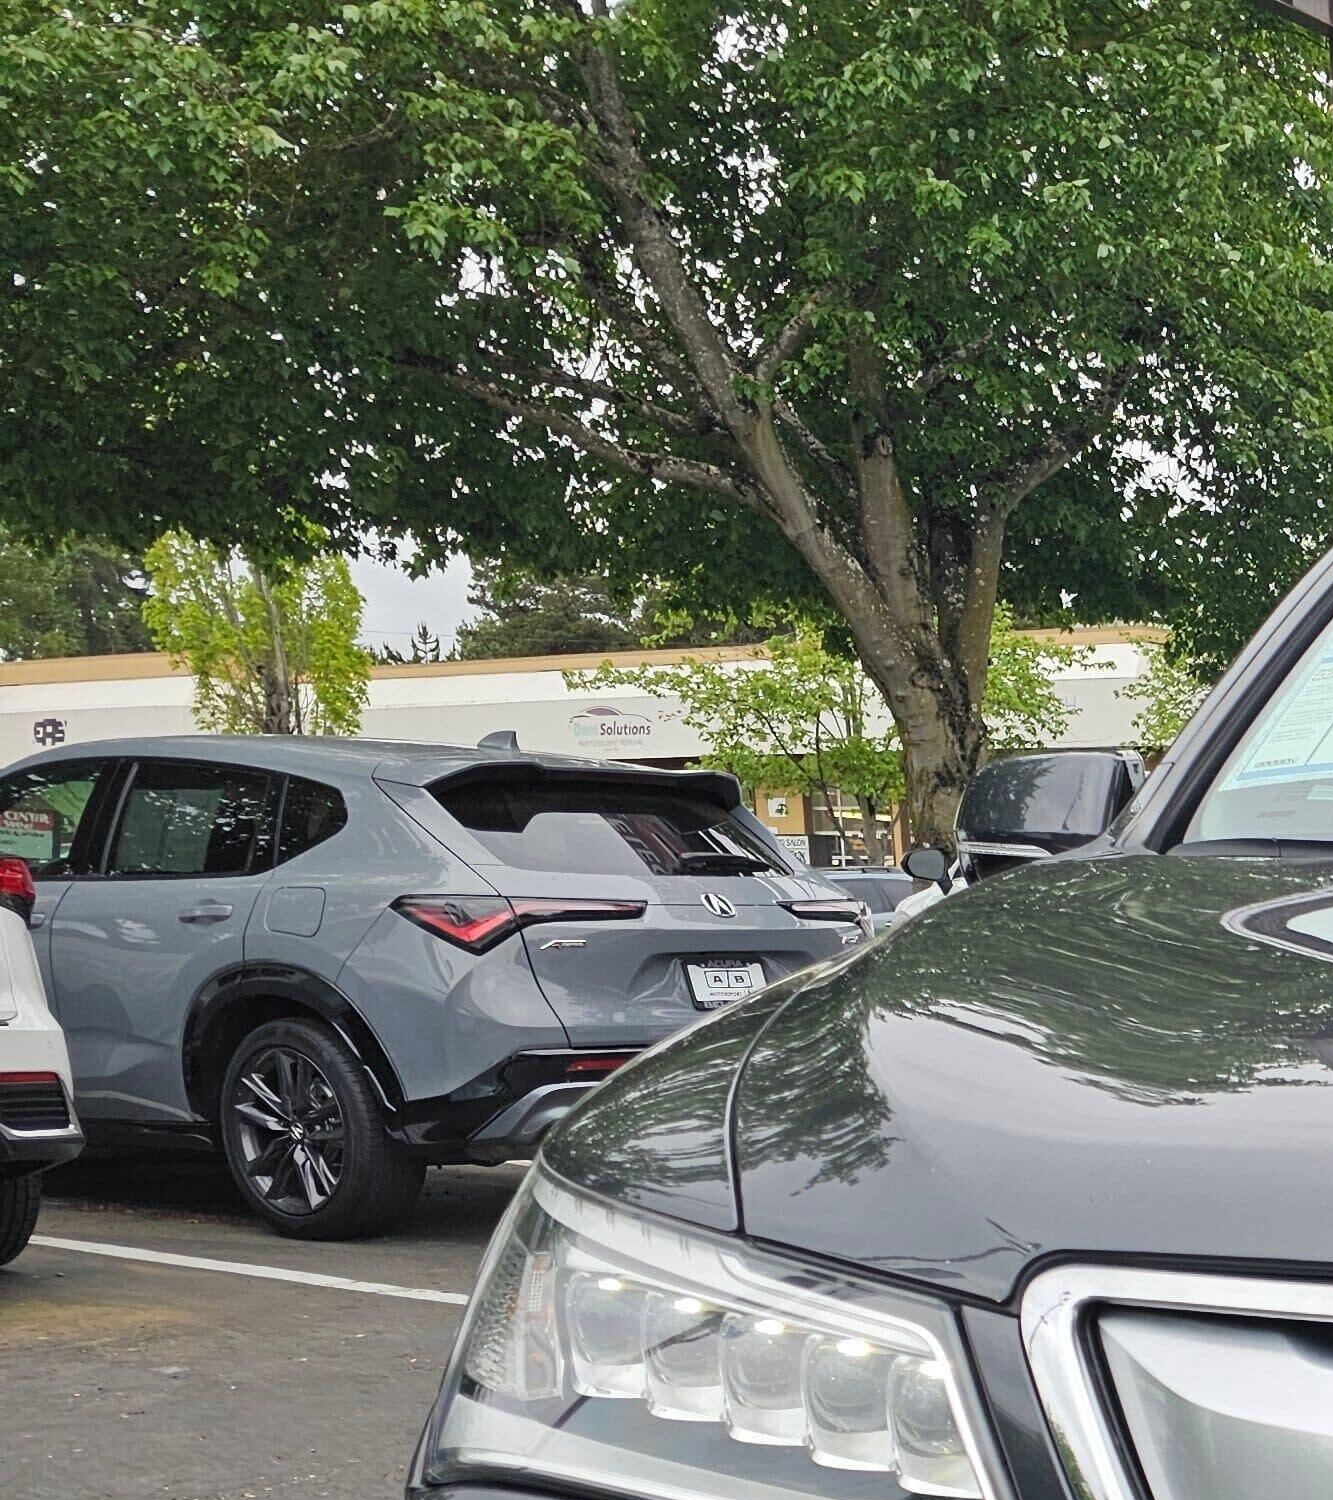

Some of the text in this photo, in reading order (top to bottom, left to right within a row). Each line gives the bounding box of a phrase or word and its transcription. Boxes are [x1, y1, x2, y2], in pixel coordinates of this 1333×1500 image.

[600, 720, 651, 736] Solutions
[707, 959, 744, 968] ACURA
[713, 975, 745, 984] A B
